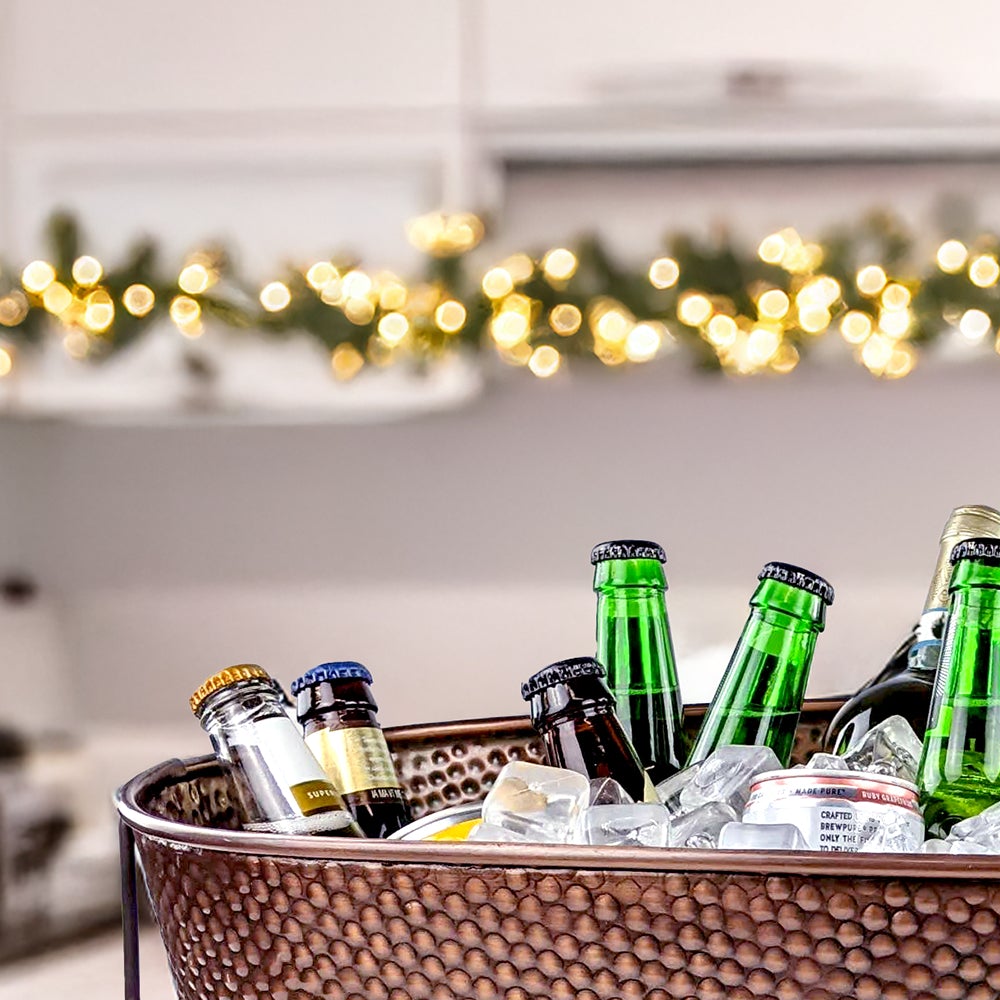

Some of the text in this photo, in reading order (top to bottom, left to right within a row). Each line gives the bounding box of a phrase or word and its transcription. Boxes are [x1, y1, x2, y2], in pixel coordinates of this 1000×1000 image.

[861, 791, 880, 800] RUBY
[820, 811, 853, 820] CRAFTED
[820, 834, 839, 842] ONLY
[842, 835, 856, 843] THE
